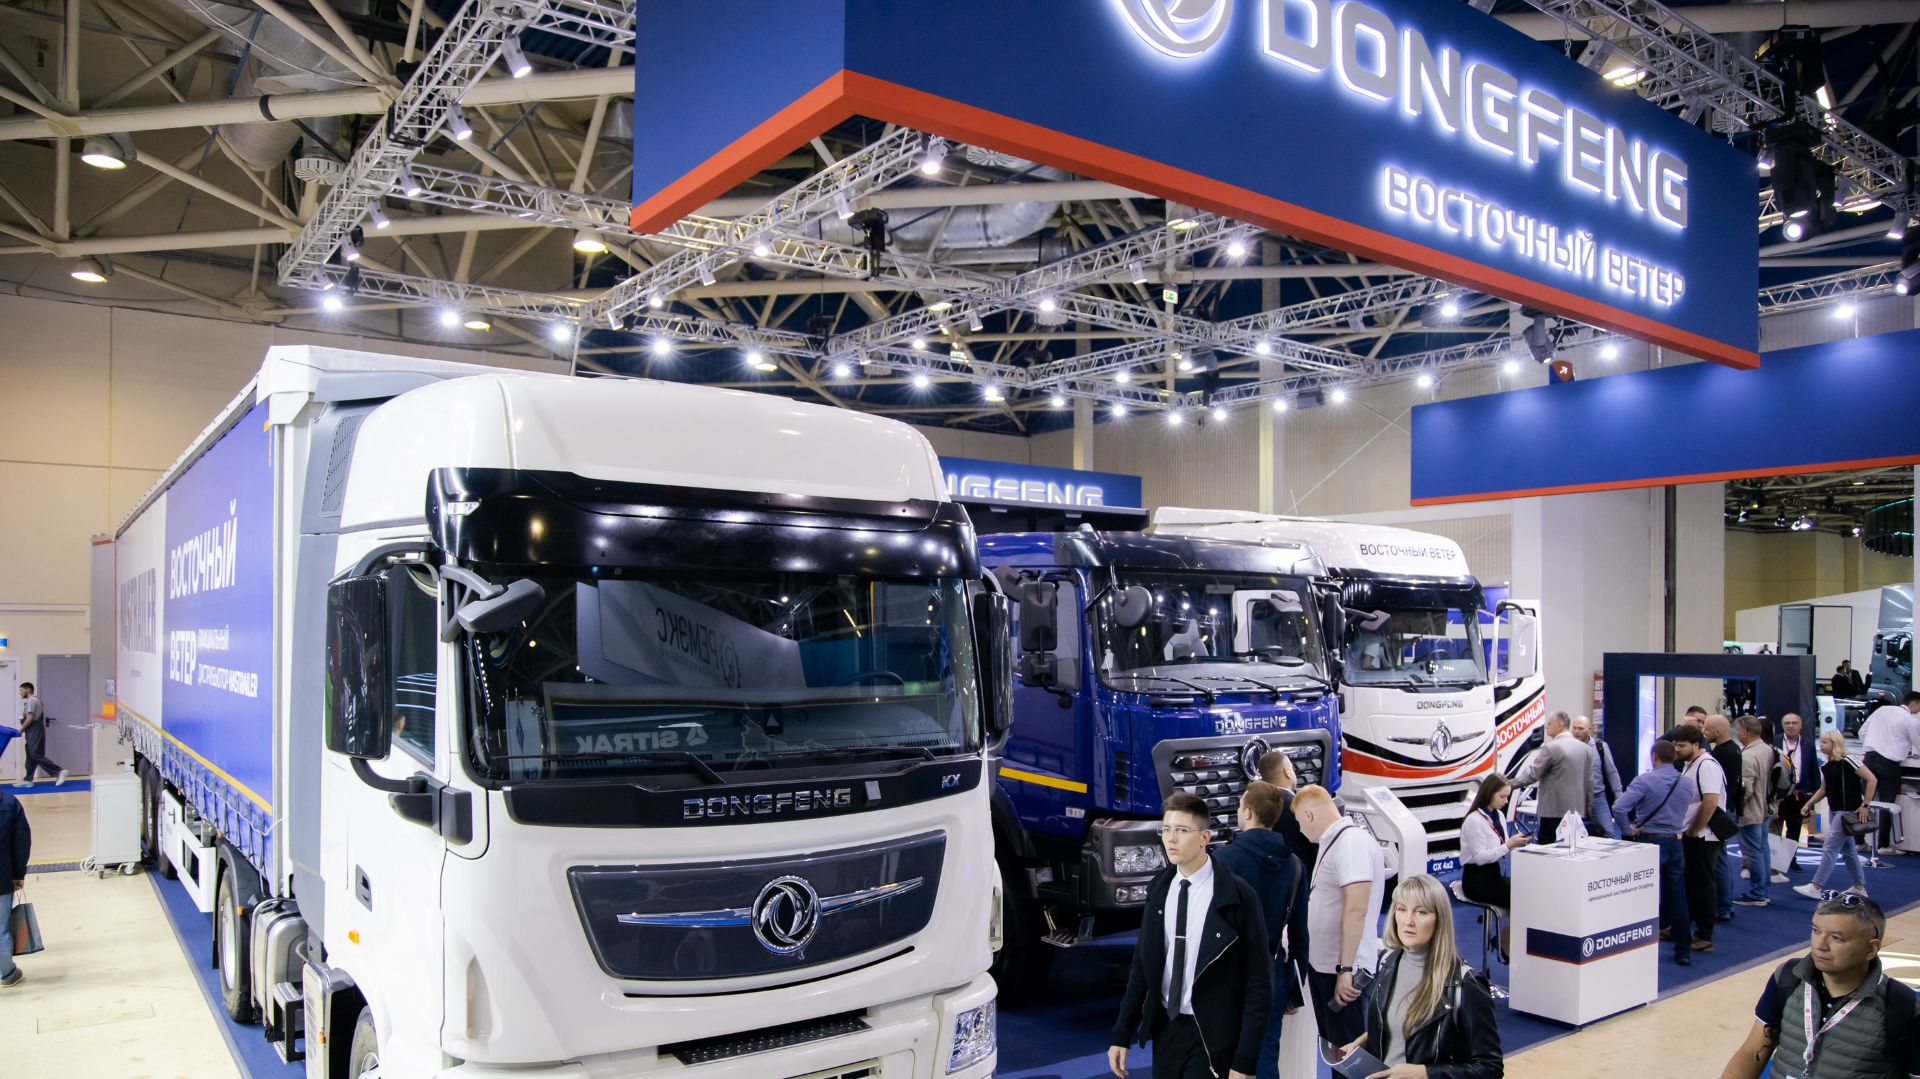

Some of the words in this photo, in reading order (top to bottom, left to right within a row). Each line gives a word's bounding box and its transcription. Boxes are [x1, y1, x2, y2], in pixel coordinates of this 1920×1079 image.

[1263, 0, 1688, 229] DONGFENG
[1383, 165, 1597, 279] ВОСТОЧНЫЙ
[1603, 246, 1687, 306] ВЕТЕР
[170, 499, 237, 599] ВОСТОЧНЫЙ
[1360, 544, 1428, 558] ВОСТОЧНЫЙ
[1429, 547, 1456, 560] ВЕТЕР
[170, 630, 197, 686] ВЕТЕР
[1416, 699, 1464, 710] DONGFENG
[1215, 715, 1287, 734] DONGFENG
[941, 773, 961, 789] KX
[683, 788, 851, 819] DONGFENG
[1587, 872, 1632, 891] ВОСТОЧНЫЙ
[1633, 868, 1655, 881] ВЕТЕР
[1596, 925, 1653, 950] DONGFENG
